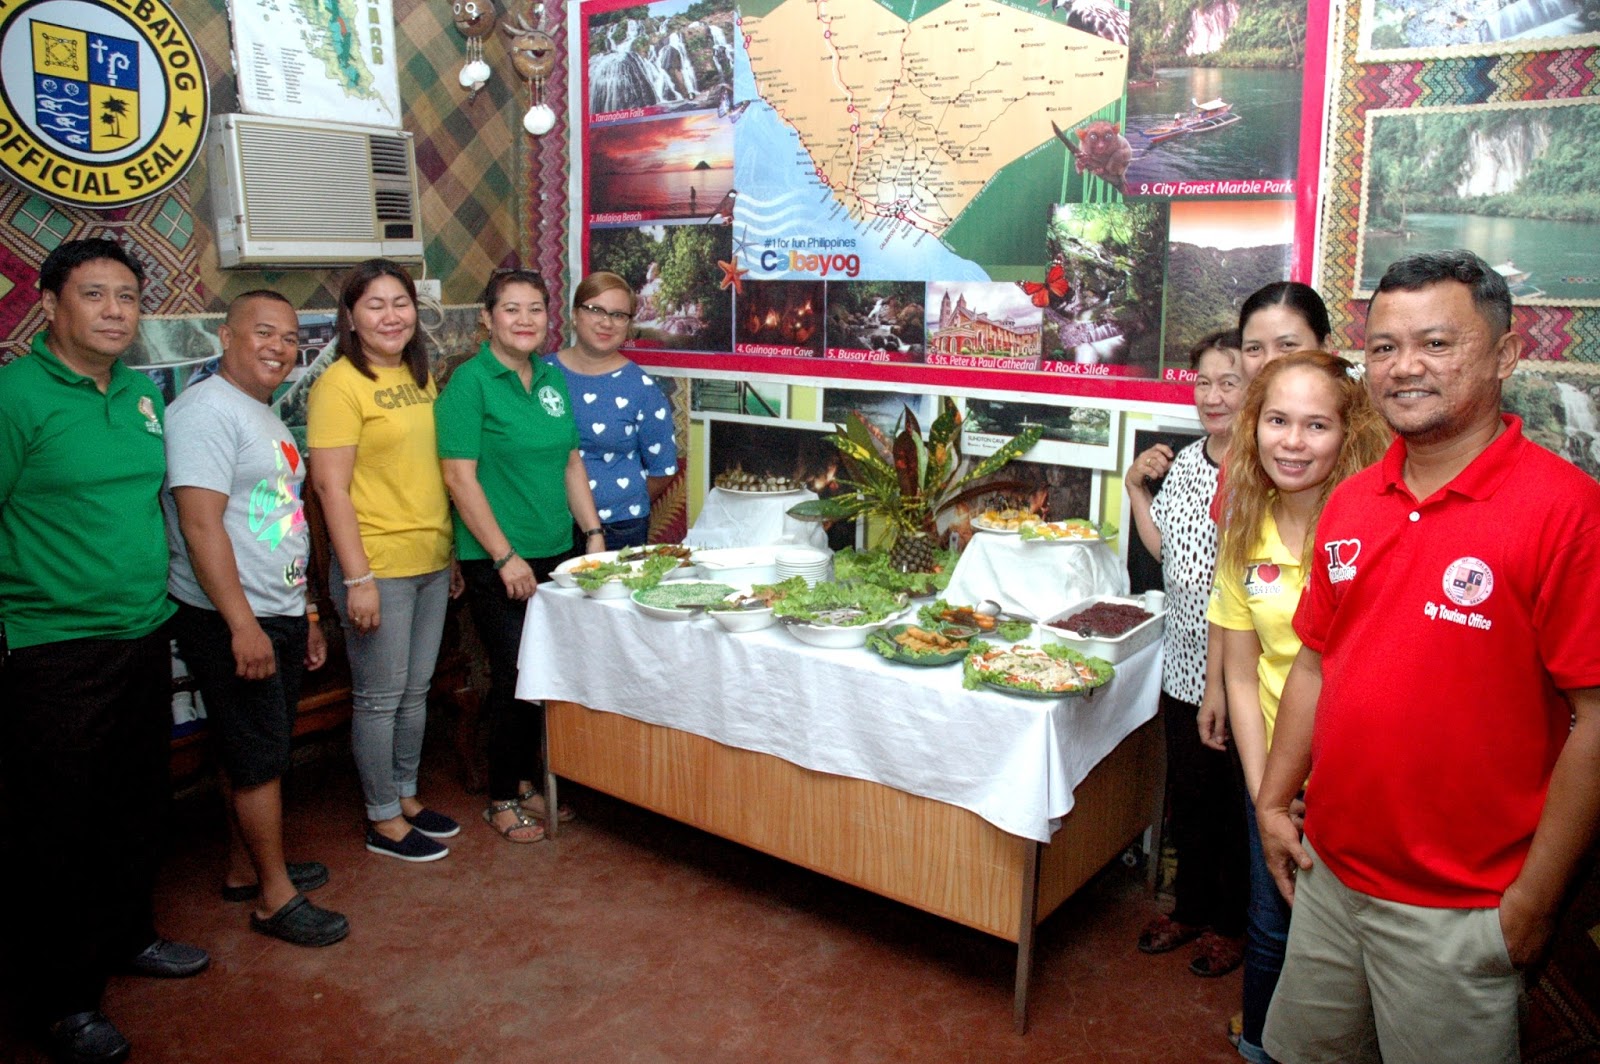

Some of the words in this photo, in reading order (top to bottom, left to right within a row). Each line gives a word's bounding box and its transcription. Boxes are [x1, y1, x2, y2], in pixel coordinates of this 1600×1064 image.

[595, 111, 629, 123] Tarangban
[629, 108, 645, 119] Falls
[124, 143, 184, 190] SEAL
[1140, 183, 1150, 195] 9.
[1152, 182, 1177, 197] City
[1178, 182, 1215, 195] Forest
[1216, 180, 1260, 194] Marble
[1263, 179, 1293, 194] Park
[596, 213, 621, 224] Malajog
[622, 211, 642, 222] Beach
[792, 238, 807, 248] fun
[807, 237, 857, 250] Philippines
[760, 250, 861, 277] Calbayog
[737, 344, 744, 353] 4.
[745, 344, 792, 357] Guinogo-an
[793, 346, 814, 357] Cave
[828, 349, 836, 359] 5.
[838, 349, 867, 362] Busay
[868, 350, 891, 362] Falls
[926, 355, 934, 365] 6.
[935, 355, 948, 366] Sts.
[950, 356, 969, 367] Peter
[970, 358, 977, 367] &
[977, 358, 996, 369] Paul
[997, 359, 1037, 371] Cathedral
[1044, 361, 1053, 372] 7.
[1055, 361, 1081, 374] Rock
[1083, 363, 1110, 376] Slide
[1166, 368, 1176, 381] 8.
[1244, 564, 1258, 586] I
[1469, 597, 1483, 605] SEAL
[1424, 601, 1438, 620] City
[1439, 604, 1468, 625] Tourism
[1468, 612, 1492, 631] Office
